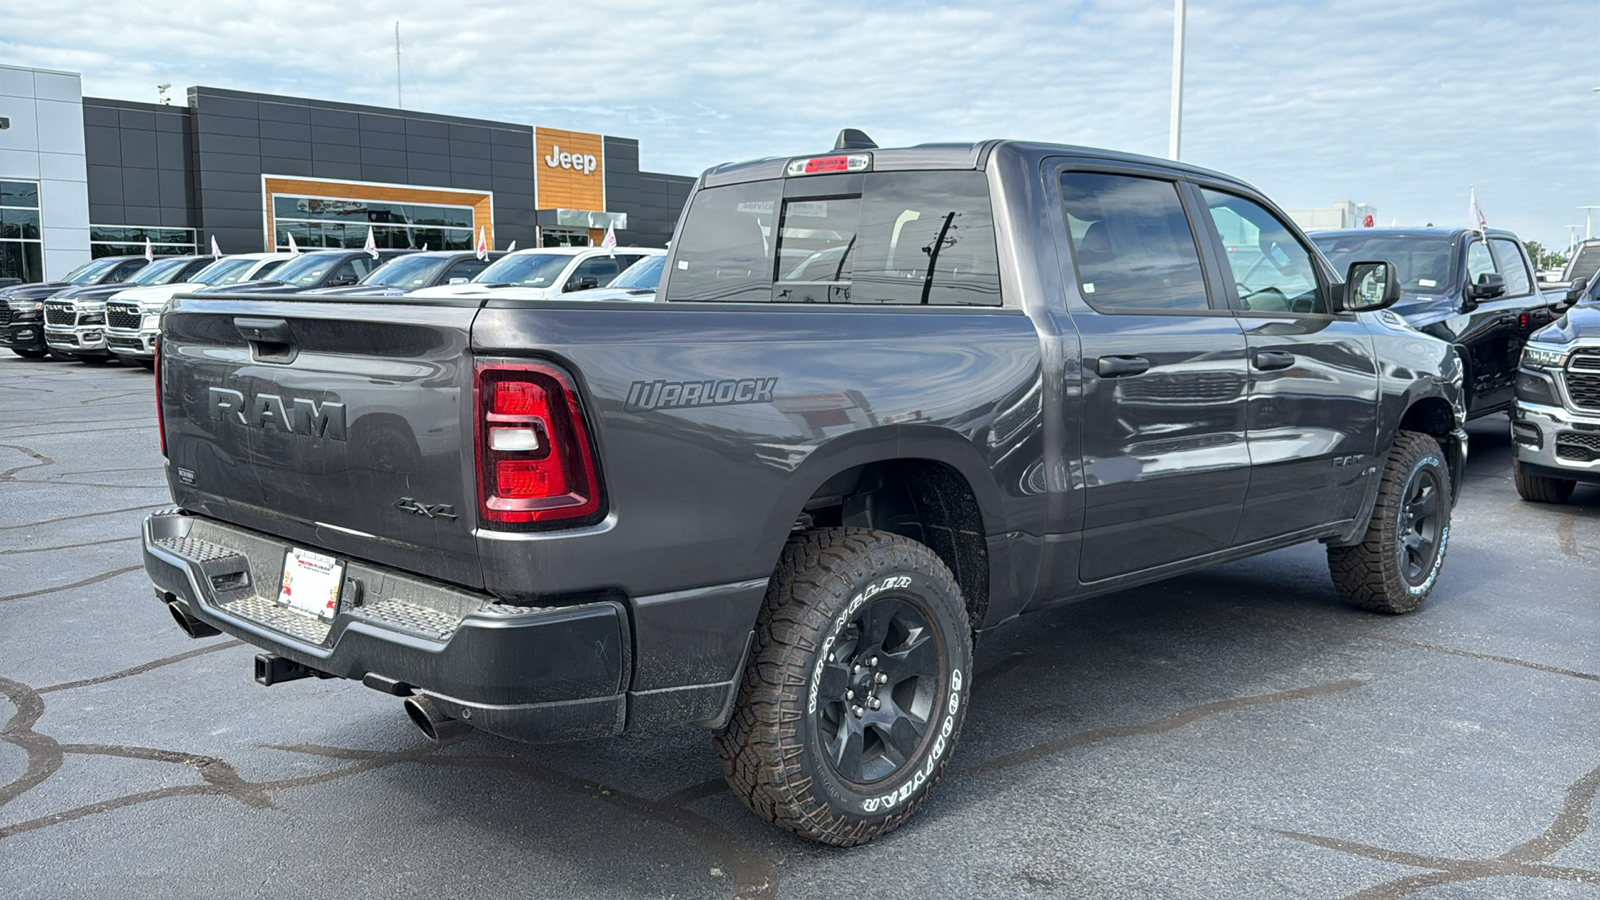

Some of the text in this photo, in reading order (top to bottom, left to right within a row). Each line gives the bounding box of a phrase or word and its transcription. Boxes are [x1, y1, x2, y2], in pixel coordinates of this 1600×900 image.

[545, 145, 597, 176] Jeep
[208, 386, 347, 442] RAM
[622, 377, 779, 413] WARLOCK
[809, 575, 912, 714] WRANGLER
[863, 669, 962, 812] GOODYEAR
